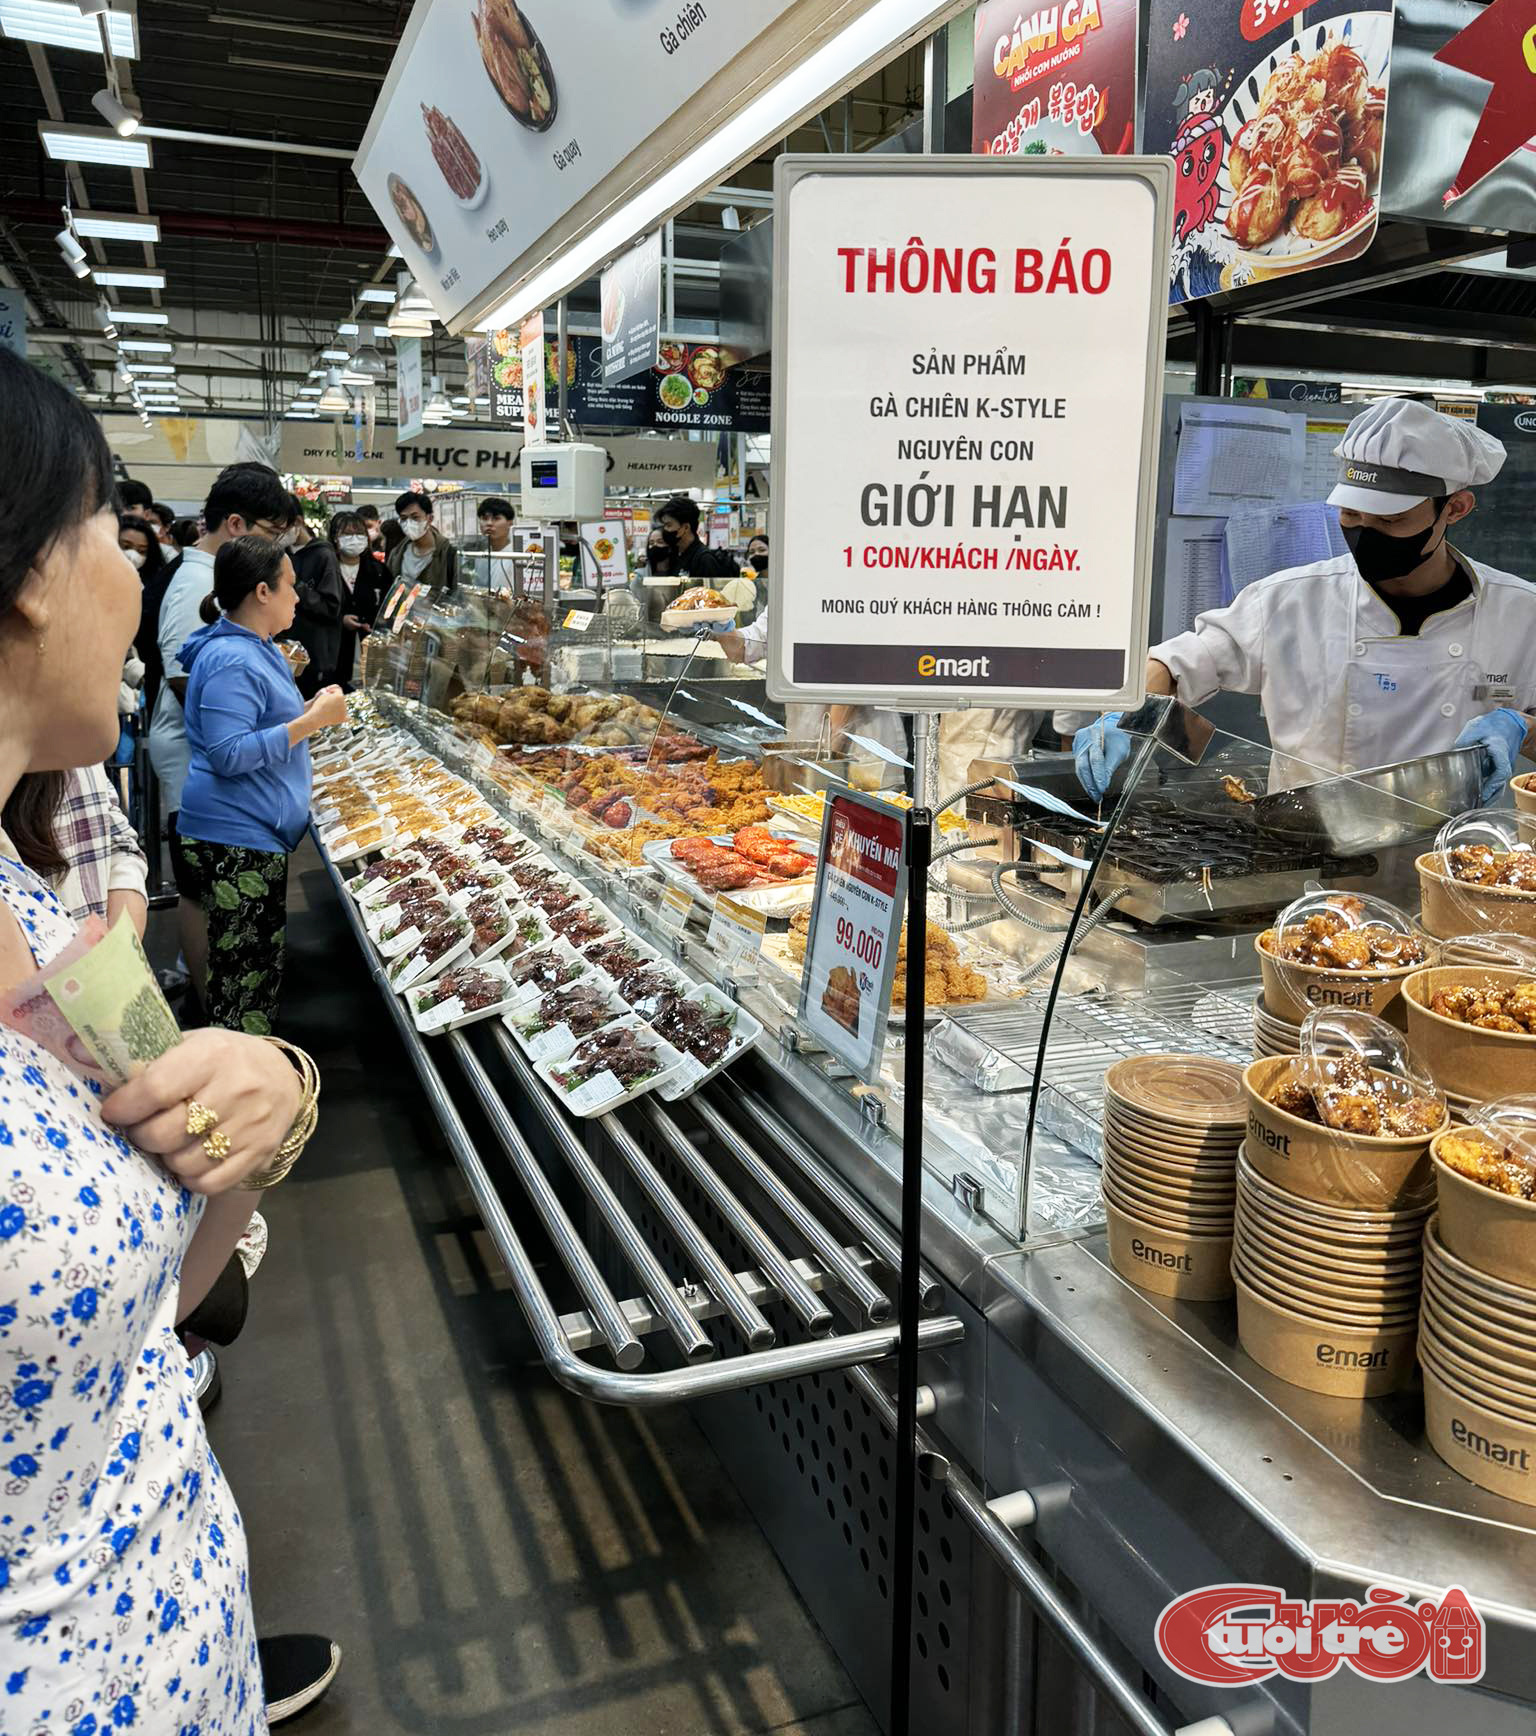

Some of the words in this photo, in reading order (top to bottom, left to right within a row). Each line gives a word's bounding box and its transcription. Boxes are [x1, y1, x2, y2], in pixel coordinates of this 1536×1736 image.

[660, 27, 680, 54] Gà
[676, 2, 707, 40] chiên
[993, 5, 1060, 77] CÁNH
[1033, 61, 1050, 75] CƠM
[838, 236, 996, 294] THÔNG
[1015, 237, 1111, 295] BÁO
[912, 347, 955, 375] SẢN
[964, 346, 1025, 375] PHẨM
[496, 394, 523, 406] MEA
[870, 392, 898, 418] GÀ
[906, 392, 968, 418] CHIÊN
[976, 398, 1066, 419] K-STYLE
[655, 411, 700, 425] NOODLE
[703, 413, 733, 426] ZONE
[303, 449, 324, 458] DRY
[397, 446, 469, 472] THỰC
[898, 435, 982, 461] NGUYÊN
[990, 440, 1033, 461] CON
[627, 462, 665, 472] HEALTHY
[667, 463, 693, 472] TASTE
[1347, 467, 1378, 483] emart
[861, 471, 954, 527] GIỚI
[972, 485, 1068, 542] HẠN
[843, 546, 853, 568] 1
[864, 542, 998, 570] CON/KHÁCH
[1005, 544, 1080, 572] /NGÀY.
[822, 599, 864, 615] MONG
[869, 597, 898, 616] QUÝ
[903, 598, 952, 616] KHÁCH
[957, 598, 997, 617] HÀNG
[1002, 600, 1052, 618] THÔNG
[1058, 599, 1091, 618] CẢM
[918, 655, 990, 678] emart
[848, 829, 883, 862] KHUYẾN
[883, 846, 900, 871] MÃ
[836, 916, 882, 969] 99.000
[1306, 984, 1373, 1006] emart
[1249, 1109, 1291, 1156] emart
[1132, 1239, 1193, 1271] emart
[1316, 1344, 1390, 1367] emart
[1451, 1418, 1531, 1471] emart
